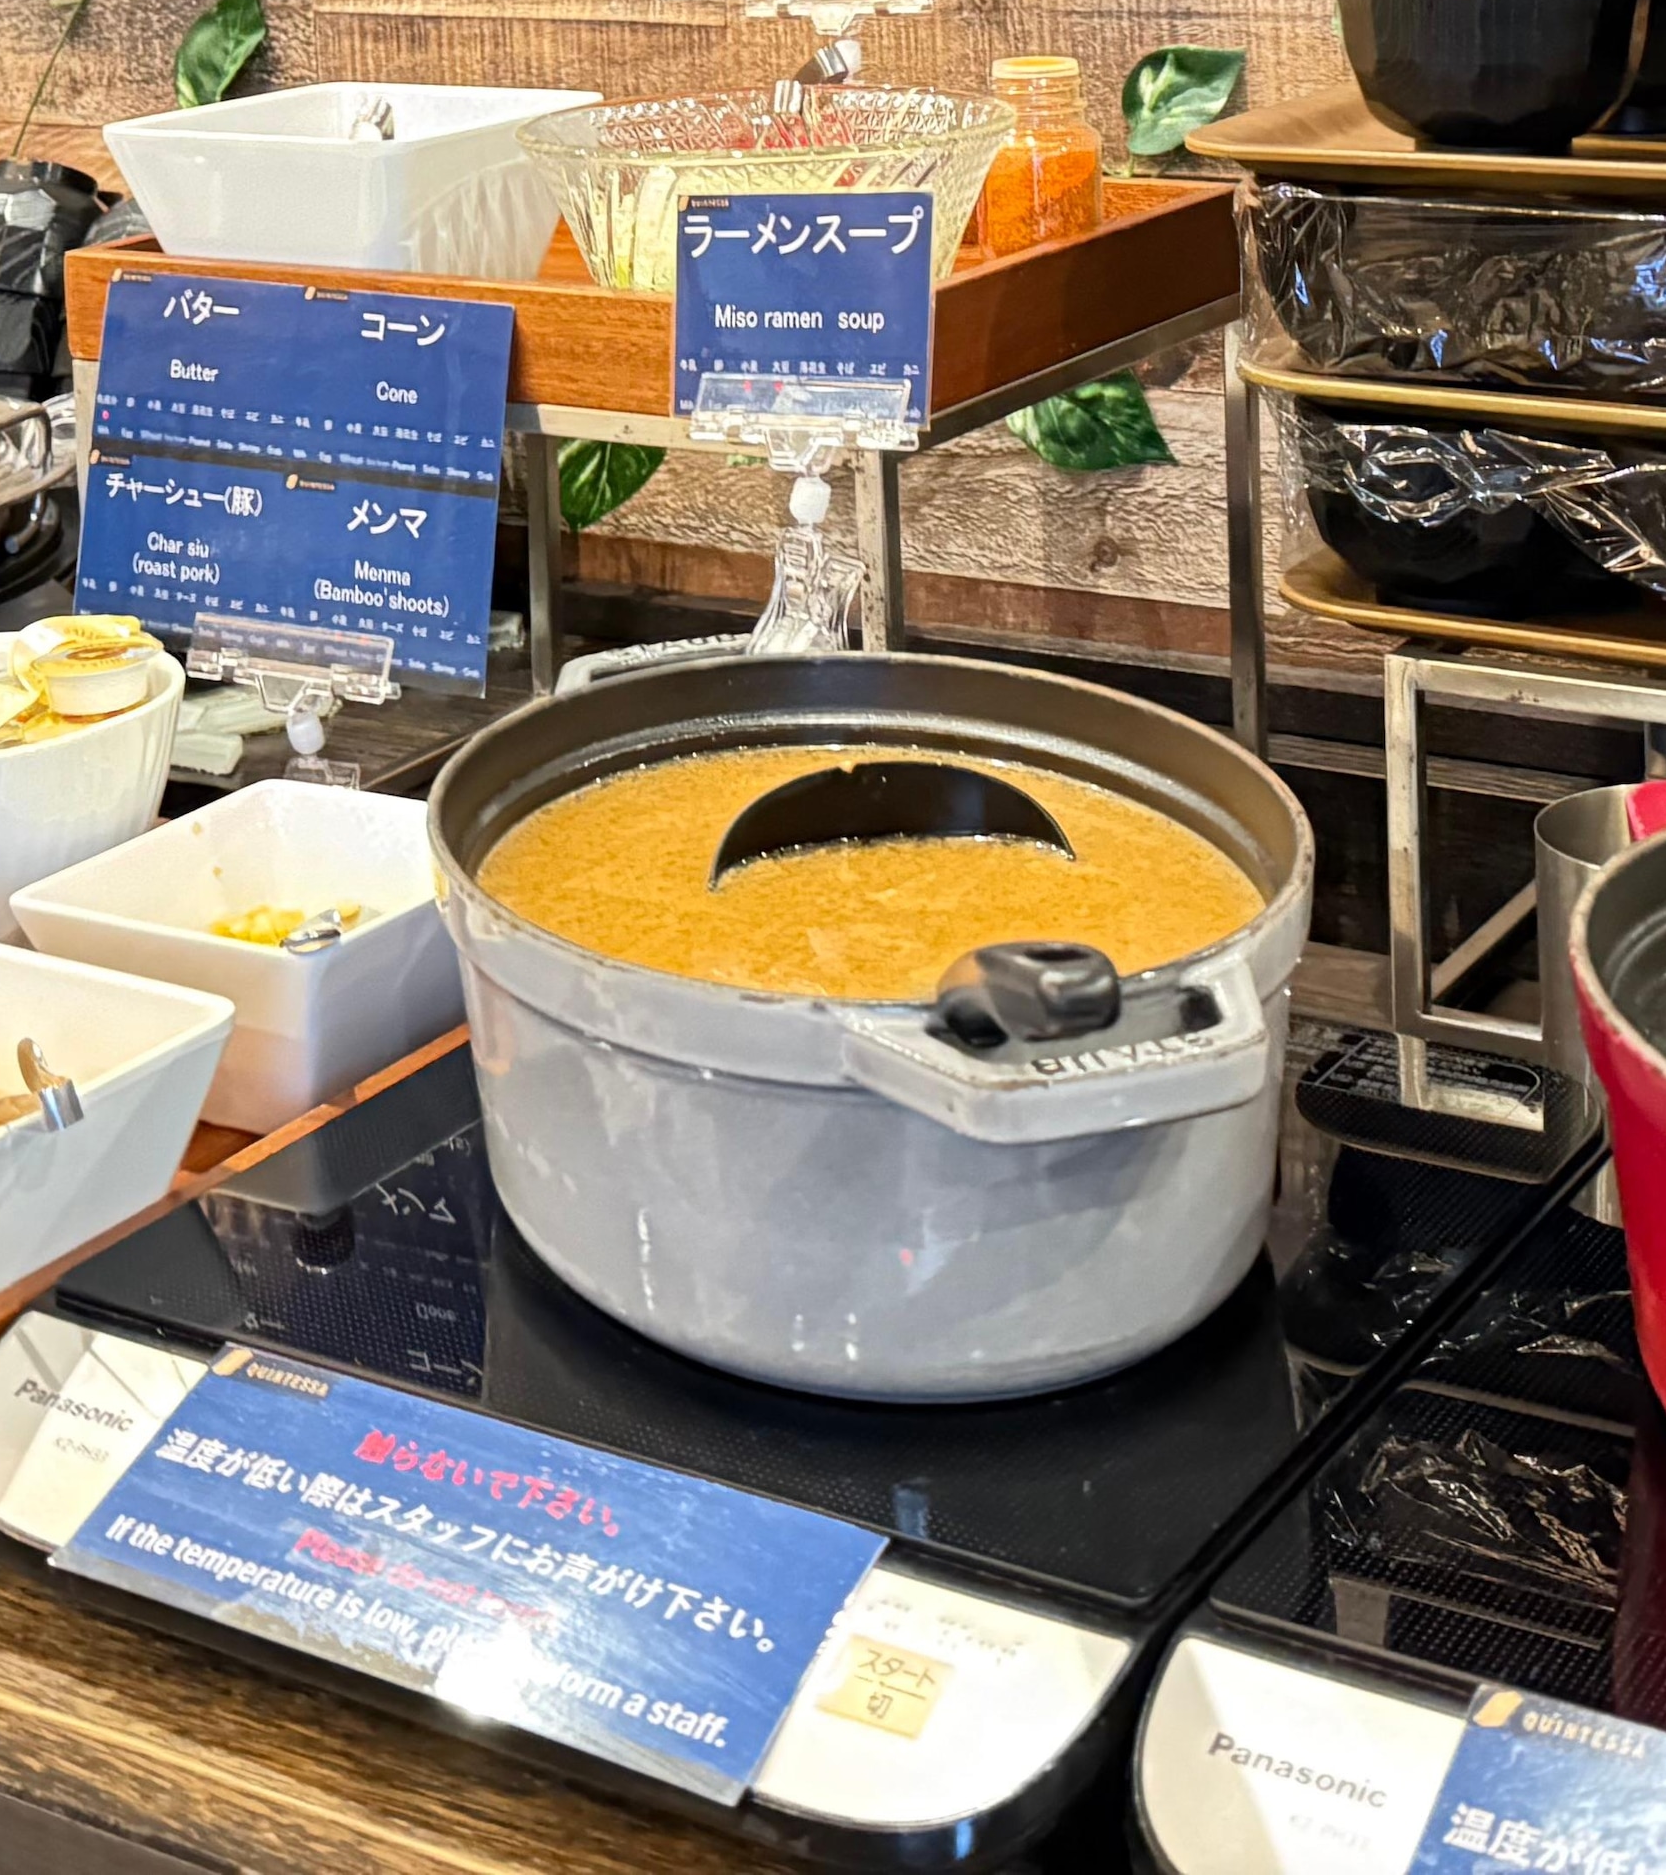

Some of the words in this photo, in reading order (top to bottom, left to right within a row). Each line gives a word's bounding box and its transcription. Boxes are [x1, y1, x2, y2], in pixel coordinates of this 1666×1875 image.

[683, 205, 925, 258] ラーメンスープ
[163, 289, 240, 325] バター
[714, 303, 758, 328] Miso
[764, 310, 823, 329] ramen
[838, 310, 885, 333] soup
[361, 311, 446, 347] コーン
[170, 358, 219, 383] Butter
[376, 381, 418, 405] Cone
[346, 499, 428, 539] メンマ
[147, 531, 184, 556] Char
[187, 536, 209, 559] siu
[132, 551, 176, 580] (roast
[180, 560, 221, 586] pork)
[354, 558, 411, 587] Menma
[313, 577, 383, 608] (Bamboo
[246, 1362, 330, 1399] QUINTESSA
[14, 1379, 133, 1432] Panasonic
[353, 1428, 621, 1538] 触らないで下さい。
[155, 1427, 775, 1654] 温度が低い際はスタッフにお声がけ下さい。
[105, 1513, 136, 1542] If
[129, 1523, 171, 1558] the
[173, 1536, 337, 1610] temperature
[337, 1589, 364, 1620] is
[363, 1598, 421, 1642] low,
[622, 1693, 648, 1718] a
[646, 1700, 730, 1749] staff.
[858, 1649, 936, 1689] スタート
[866, 1691, 894, 1719] 切
[1523, 1710, 1646, 1759] QUINTESSA
[1207, 1731, 1387, 1809] Panasonic
